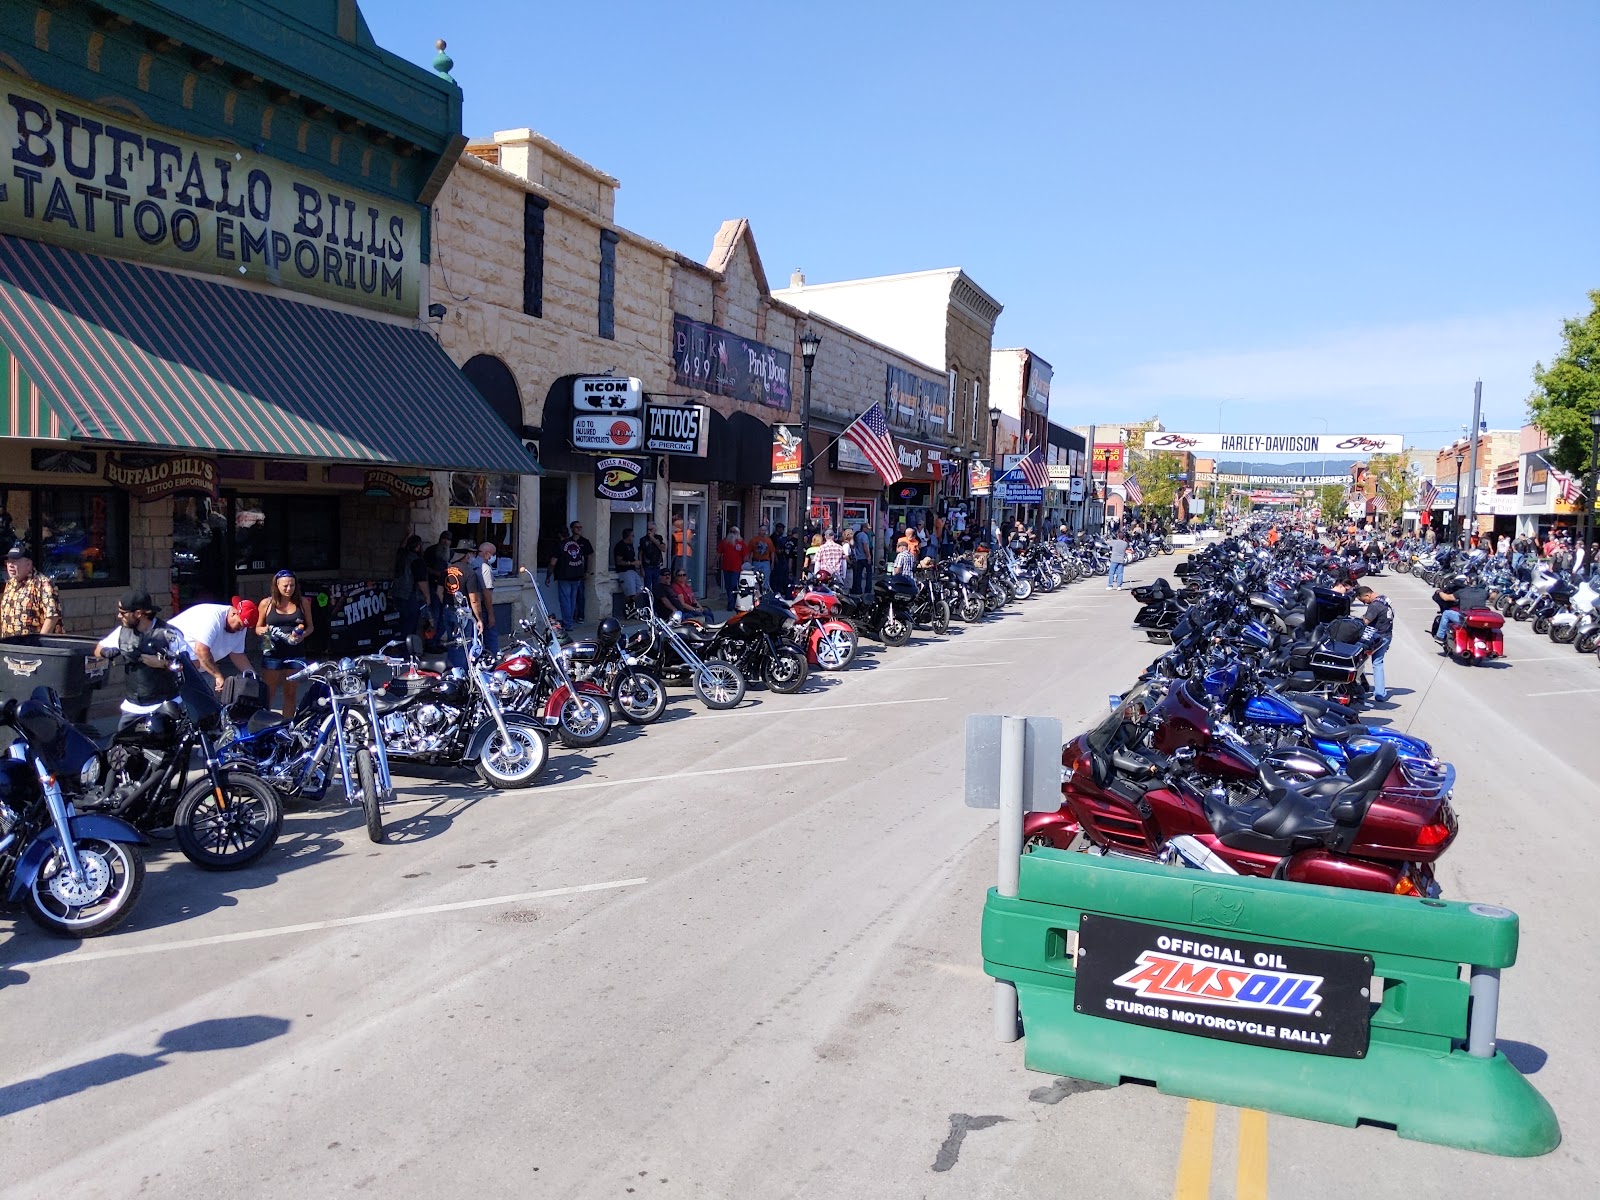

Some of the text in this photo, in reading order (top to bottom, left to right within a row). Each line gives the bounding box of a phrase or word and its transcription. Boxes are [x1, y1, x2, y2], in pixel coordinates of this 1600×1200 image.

[8, 94, 404, 263] BUFFALO BILLS
[13, 166, 402, 301] TATTOO EMPORIUM
[748, 349, 770, 391] Pink
[584, 383, 628, 392] NCOM
[649, 407, 699, 439] TATTOOS
[658, 441, 691, 450] PIERCING
[1221, 435, 1319, 452] HARLEY-DAVIDSON
[108, 459, 213, 485] BUFFALO BILL'S
[600, 459, 640, 472] HELLS ANGELS
[1196, 473, 1217, 481] RUSS
[1218, 474, 1249, 483] BROWN
[1249, 475, 1303, 484] MOTORCYCLE
[1303, 475, 1354, 483] ATTORNEYS
[146, 477, 214, 494] TATTOO EMPORIUM
[368, 471, 431, 497] PIERCINGS
[344, 590, 387, 625] TATTOO
[1157, 935, 1287, 969] OFFICIAL OIL
[1120, 953, 1321, 1011] AMSOIL
[1105, 997, 1331, 1045] STURGIS MOTORCYCLE RALLY
